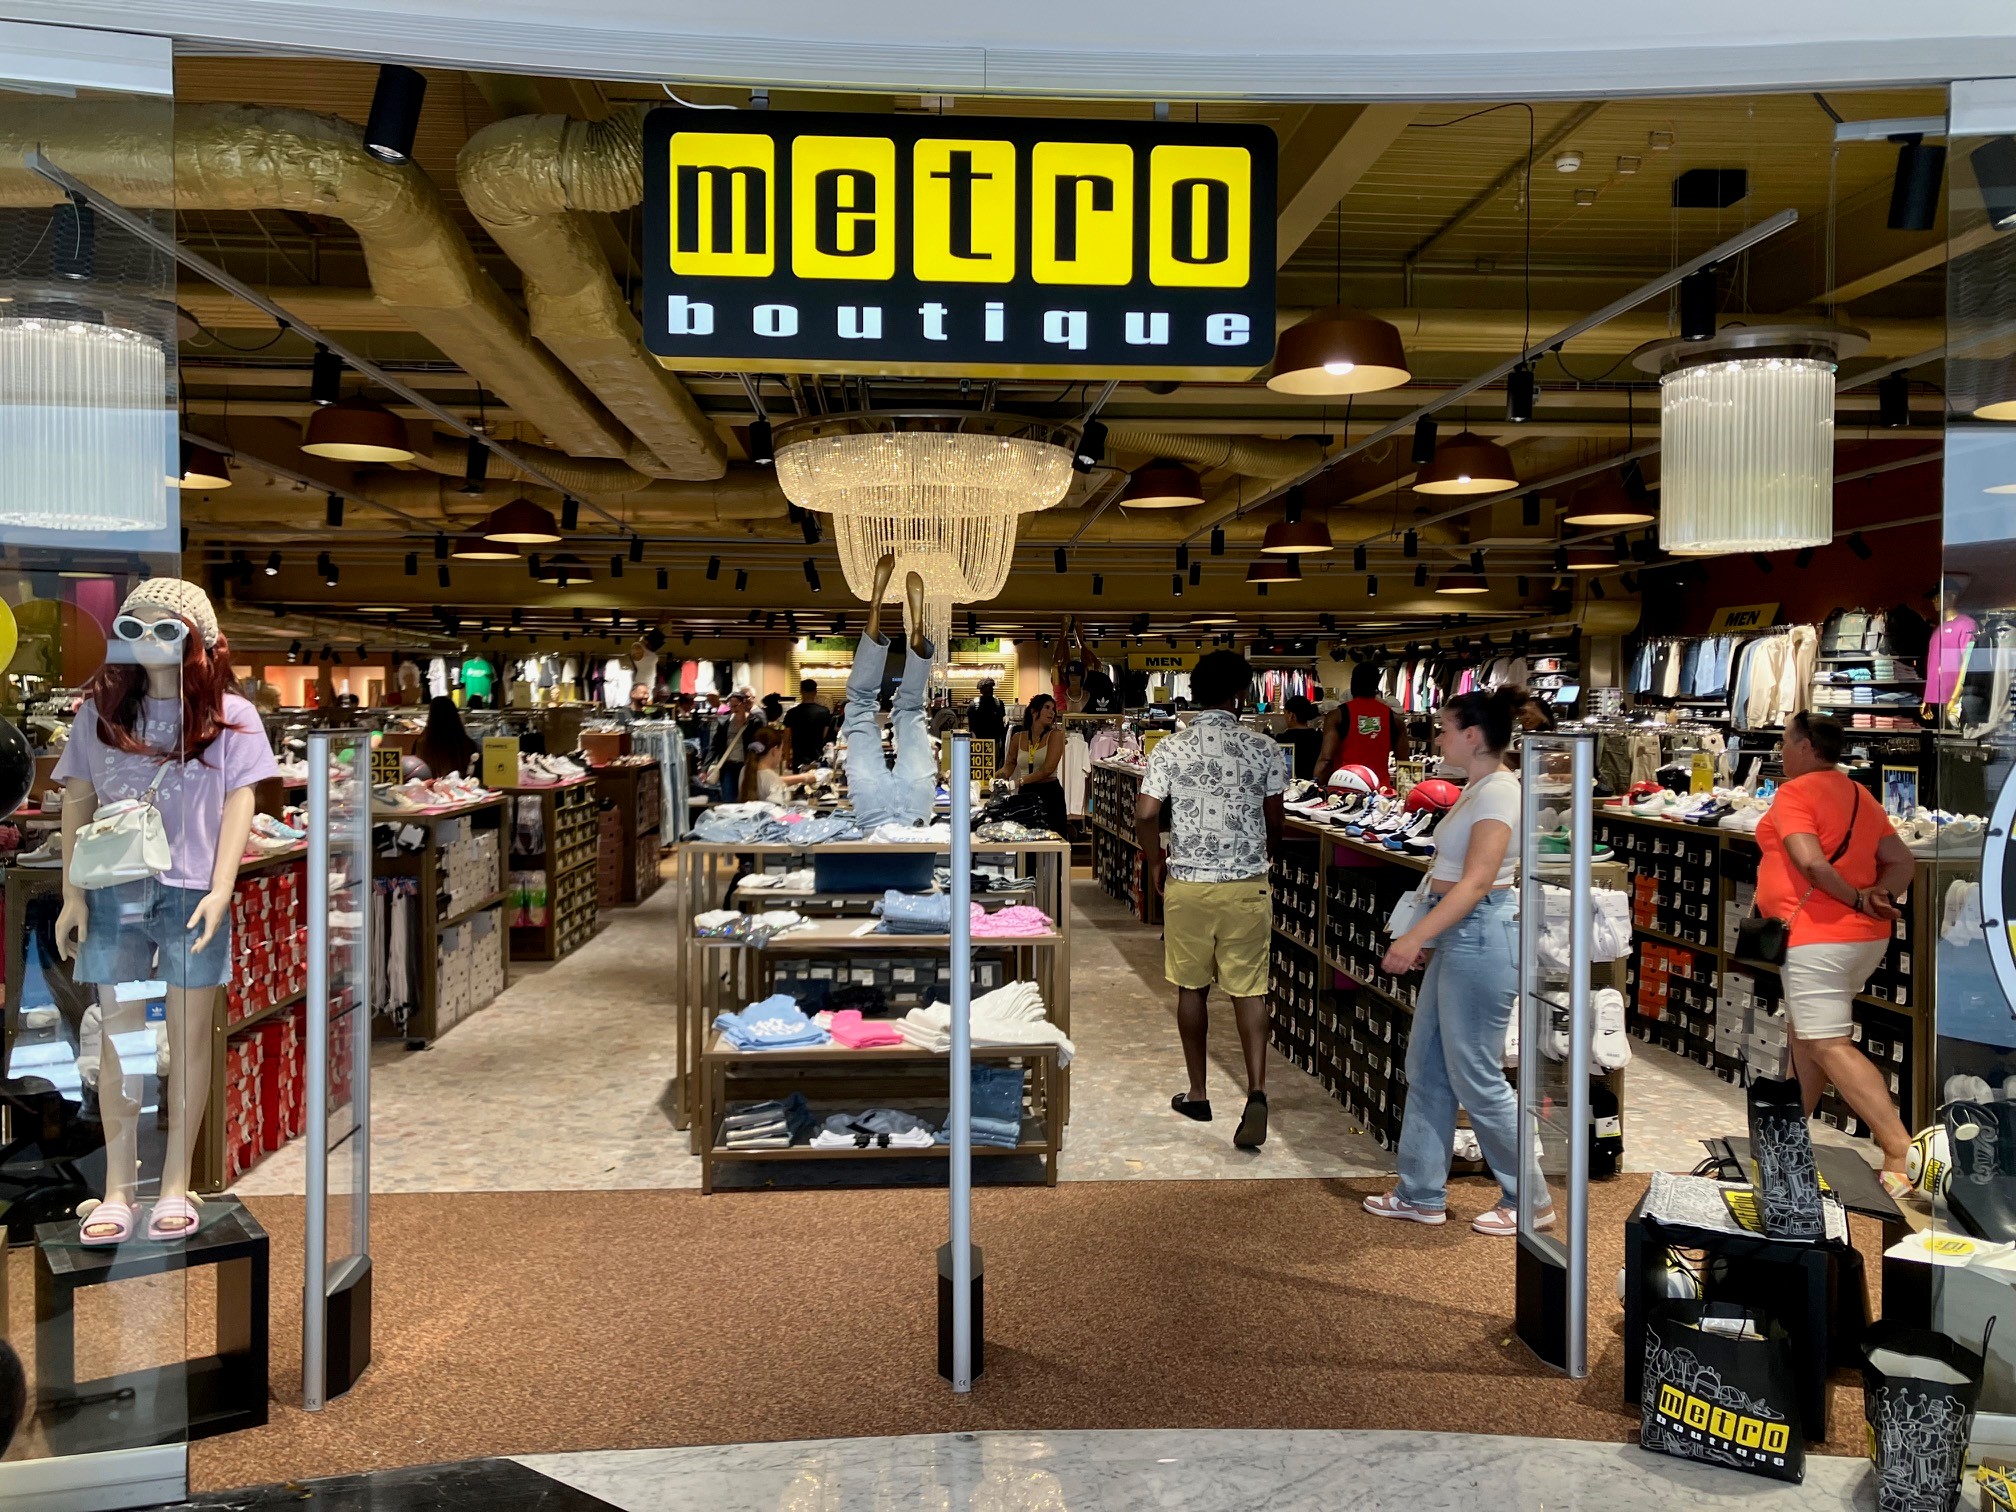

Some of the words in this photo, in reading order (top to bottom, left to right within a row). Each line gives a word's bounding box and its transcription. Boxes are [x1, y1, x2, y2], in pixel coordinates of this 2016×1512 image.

[676, 149, 1231, 265] metro
[667, 294, 1250, 350] boutique
[1725, 610, 1761, 627] MEN
[1145, 657, 1182, 667] MEN
[133, 720, 175, 734] UESS
[1656, 1413, 1786, 1467] boutique
[1661, 1390, 1784, 1448] metro
